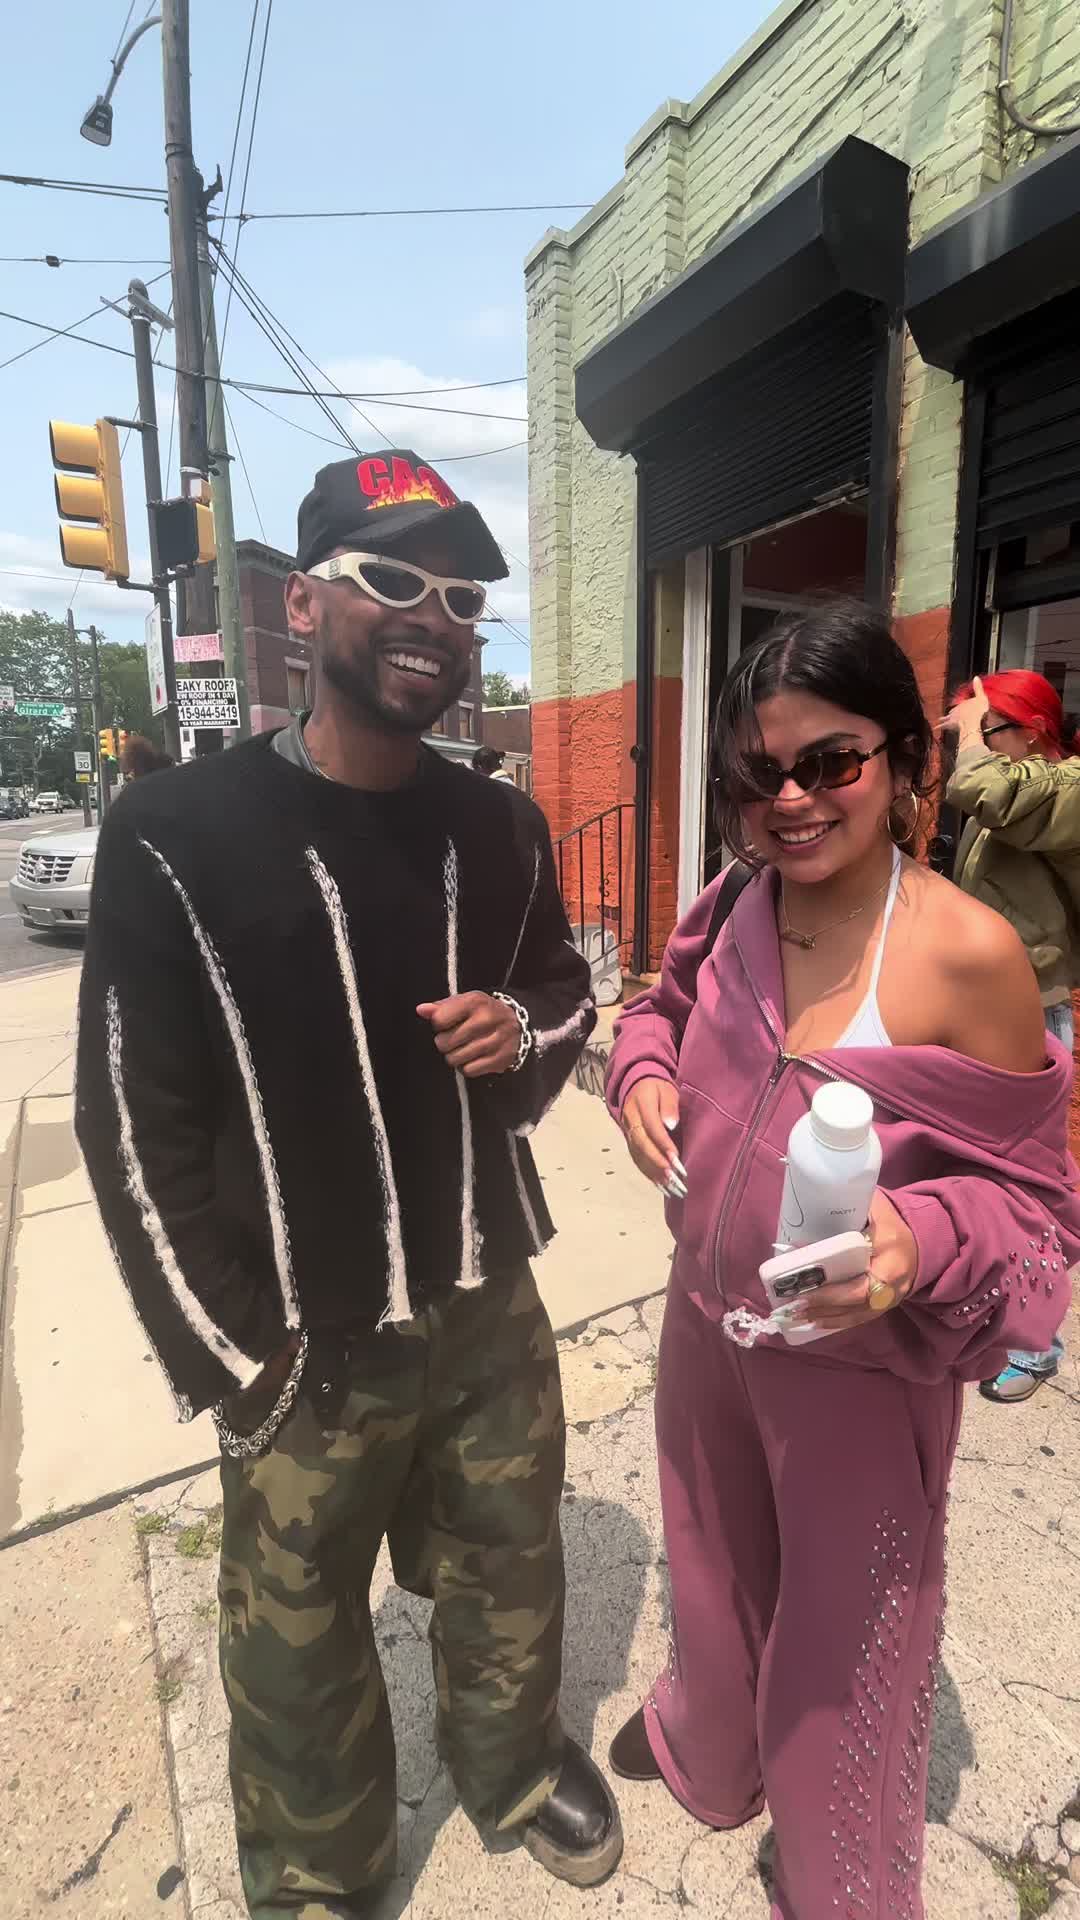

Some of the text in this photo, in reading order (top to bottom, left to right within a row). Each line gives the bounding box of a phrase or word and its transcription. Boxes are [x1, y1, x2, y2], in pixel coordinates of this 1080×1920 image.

[177, 680, 234, 691] EAKY ROOF?
[19, 707, 48, 715] Girard
[179, 706, 238, 719] 15-944-5419
[77, 761, 90, 769] 30
